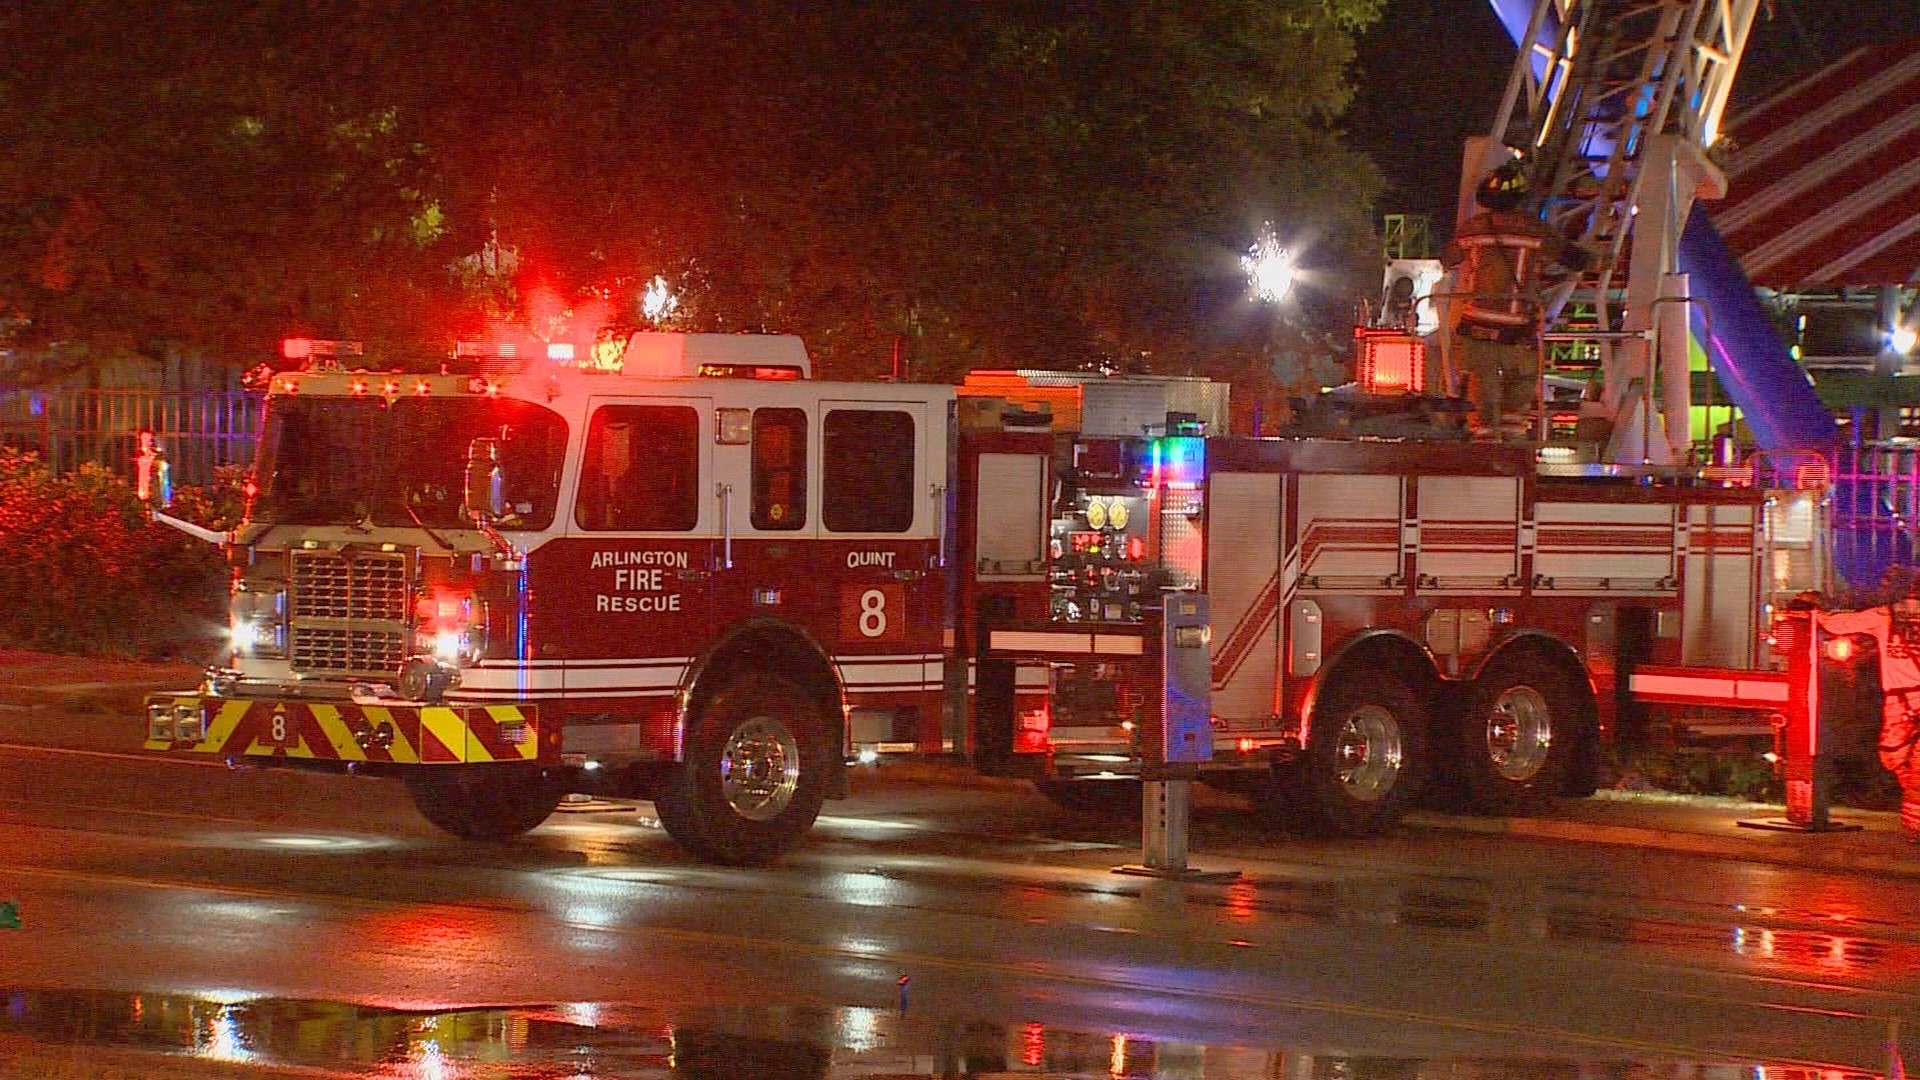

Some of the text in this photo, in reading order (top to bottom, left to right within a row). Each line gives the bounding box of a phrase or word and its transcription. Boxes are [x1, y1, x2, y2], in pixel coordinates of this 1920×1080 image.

[590, 551, 688, 569] ARLINGTON
[847, 551, 896, 568] QUINT
[615, 569, 663, 591] FIRE
[596, 594, 681, 612] RESCUE
[858, 589, 887, 637] 8
[272, 715, 286, 741] 8
